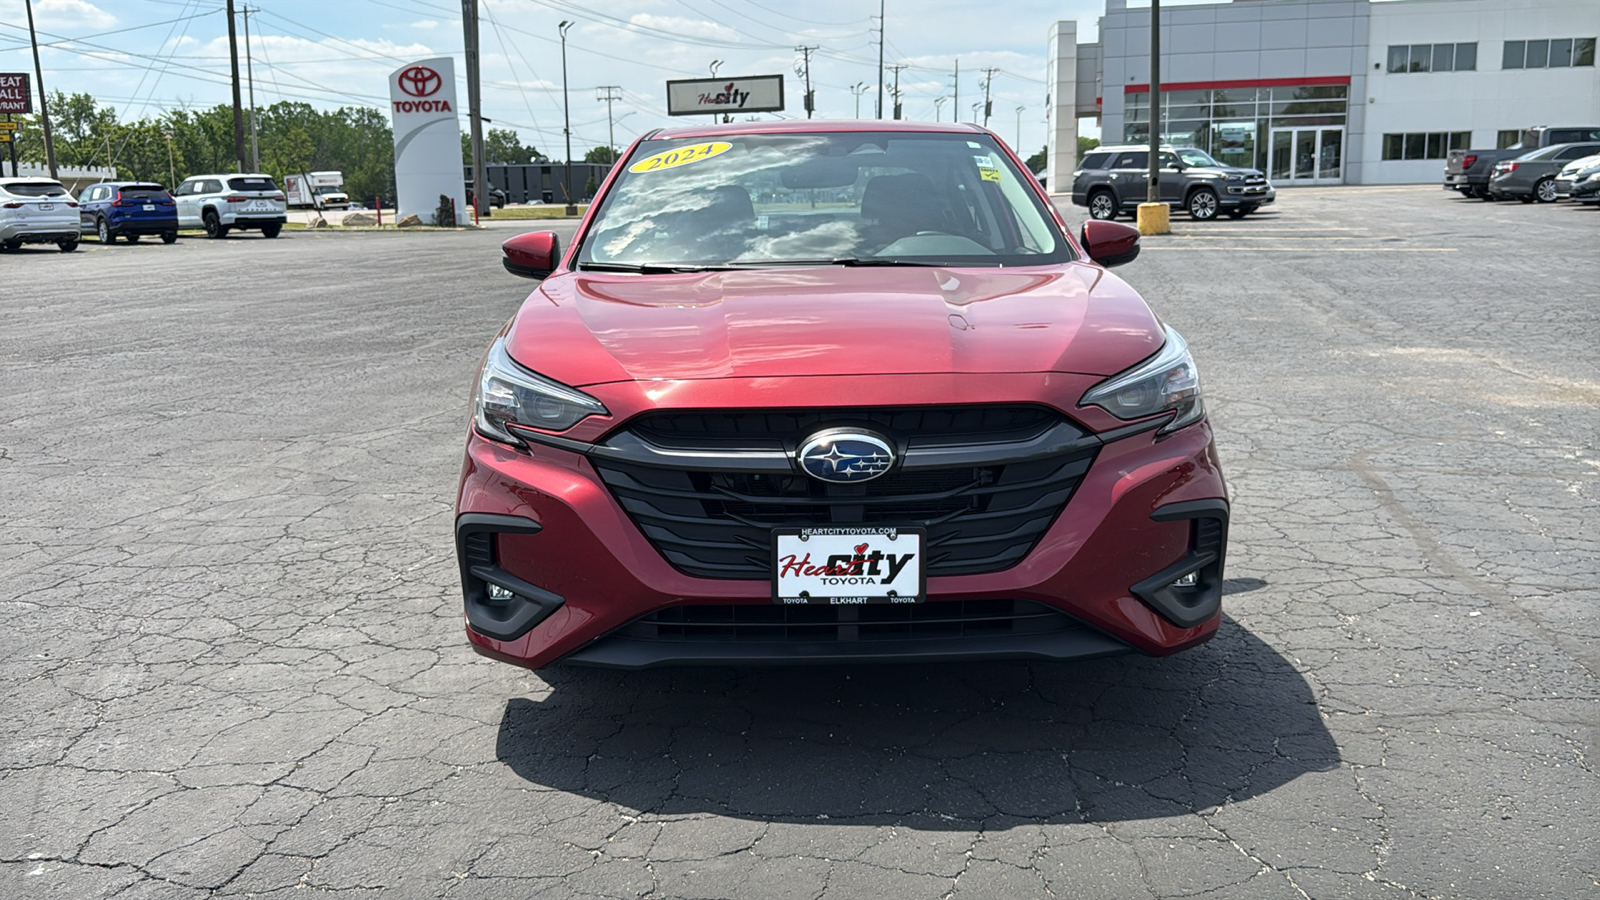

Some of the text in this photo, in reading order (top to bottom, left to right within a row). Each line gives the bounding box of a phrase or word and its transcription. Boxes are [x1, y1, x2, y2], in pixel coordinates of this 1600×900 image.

[0, 76, 22, 87] EAT
[0, 101, 26, 110] RANT
[392, 100, 452, 113] TOYOTA
[647, 143, 714, 171] 2024
[779, 544, 915, 585] Heart city
[820, 577, 876, 585] TOYOTA
